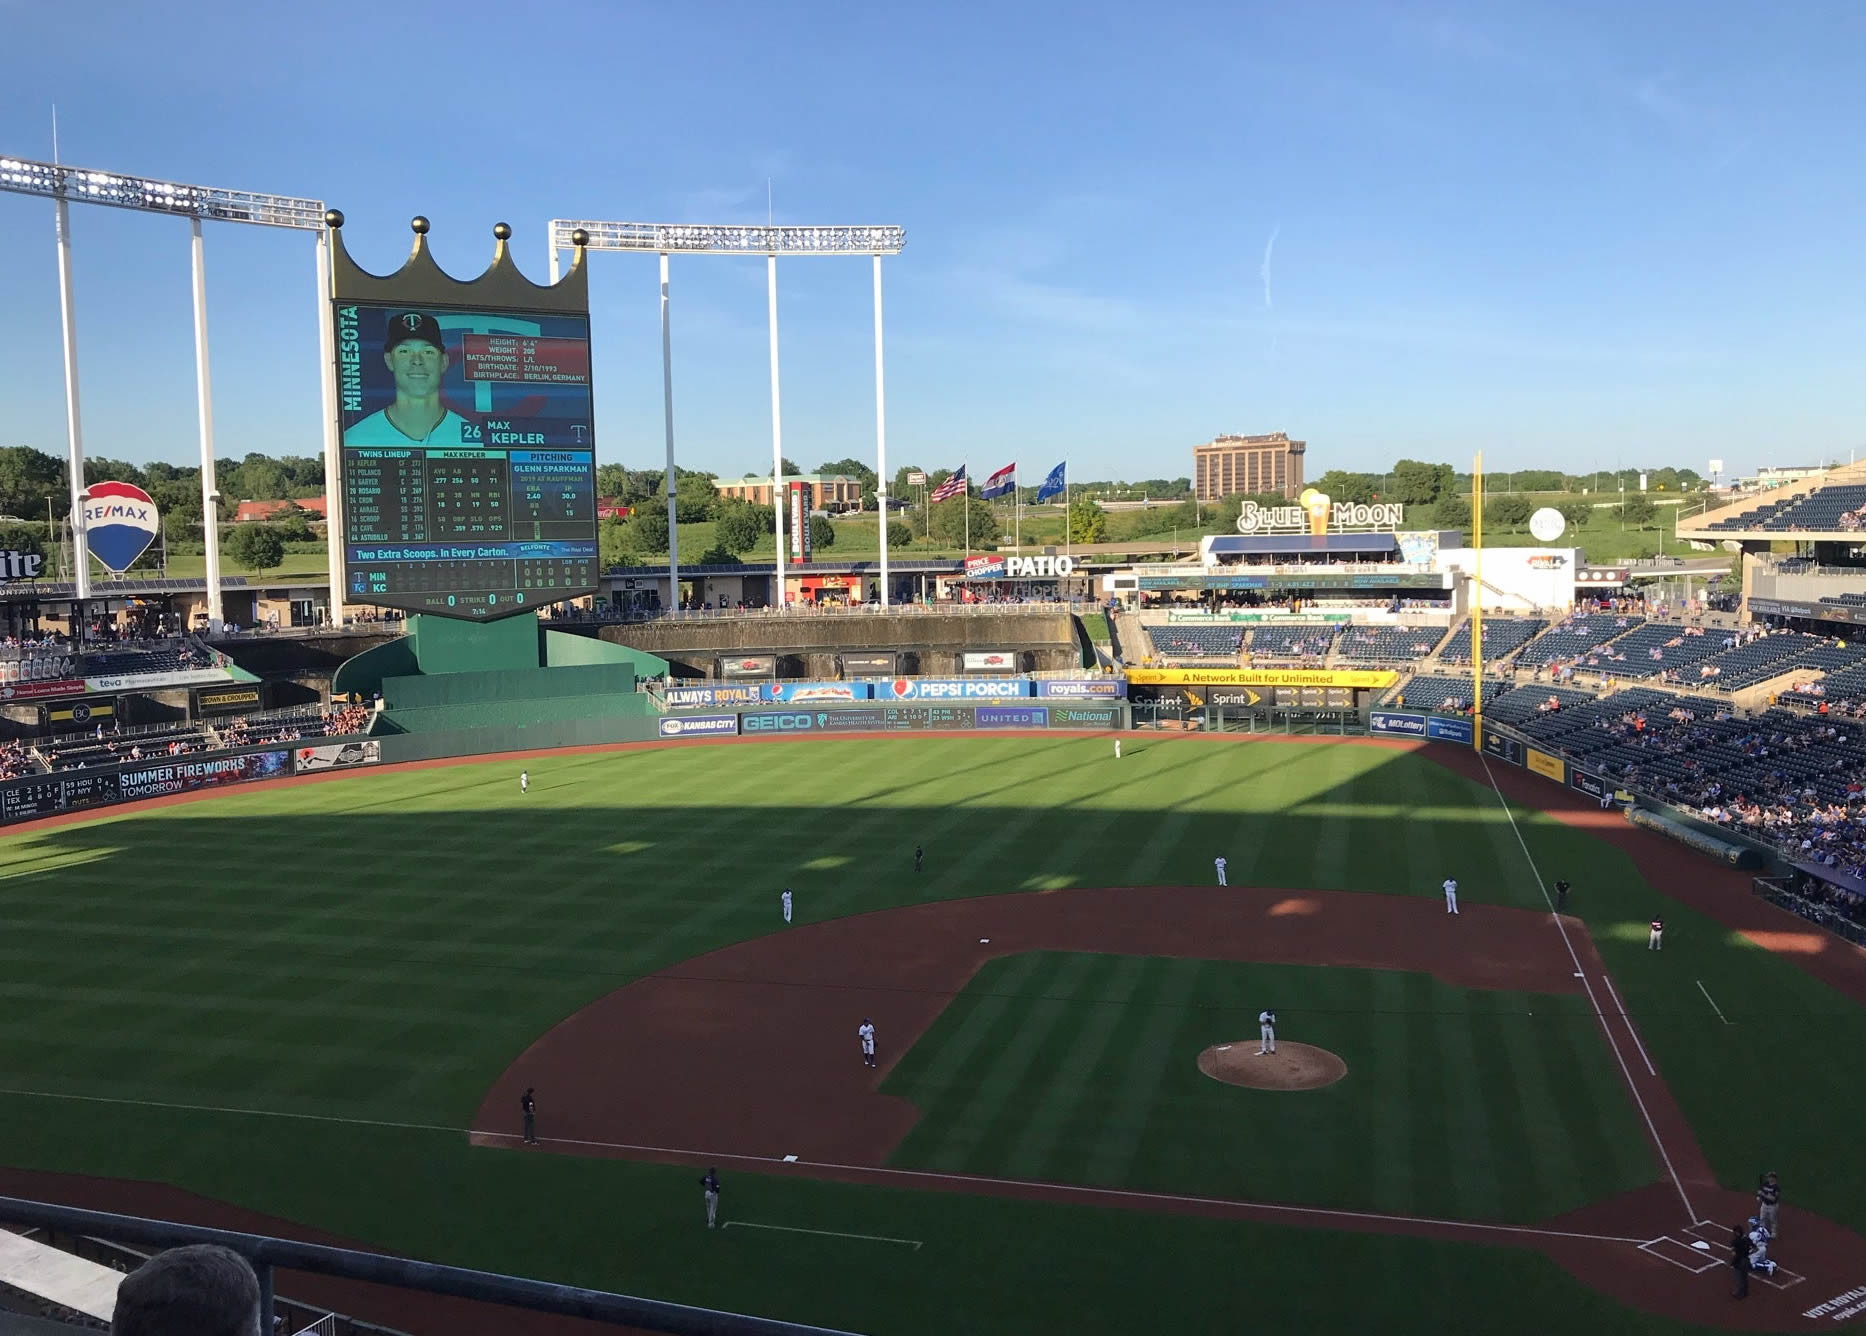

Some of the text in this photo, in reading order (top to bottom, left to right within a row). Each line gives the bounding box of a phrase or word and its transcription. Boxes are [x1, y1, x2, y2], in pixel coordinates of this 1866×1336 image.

[490, 338, 519, 346] HEIGHT:
[489, 346, 519, 354] WEIGHT:
[340, 305, 361, 411] MINNESOTA
[467, 354, 519, 362] BATS/THROWS:
[478, 363, 519, 371] BIRTHDATE:
[473, 371, 520, 379] BIRTHPLACE:
[552, 374, 585, 382] GERMANY
[487, 421, 511, 430] MAX
[463, 424, 482, 439] 26
[491, 432, 545, 445] KEPLER
[358, 450, 411, 458] TWINS LINEUP
[530, 453, 573, 461] PITCHING
[514, 465, 588, 473] GLENN SPARKMAN
[85, 505, 148, 521] RE/MAX
[1332, 502, 1403, 525] MOON
[520, 543, 551, 551] BELFONTE
[356, 547, 509, 560] Two Extra Scoops. In Every Carton.
[0, 550, 41, 578] ite
[967, 556, 989, 569] PRICE
[1007, 556, 1073, 577] PATIO
[966, 564, 1003, 578] CHOPPER
[369, 572, 386, 581] MIN
[0, 588, 34, 596] UNTAIN
[373, 584, 387, 592] KC
[447, 595, 456, 607] 0
[488, 593, 496, 605] 0
[516, 592, 524, 604] 0
[100, 679, 121, 688] teva
[1183, 674, 1334, 684] A Network Built for Unlimited
[921, 682, 1020, 697] PEPSI PORCH
[1050, 684, 1115, 696] royals.com
[667, 689, 750, 703] ALWAYS ROYAL
[1213, 693, 1246, 706] Sprint
[75, 709, 88, 718] BC
[981, 714, 1030, 722] UNITED
[1068, 711, 1113, 721] National
[684, 720, 716, 730] KANSAS
[717, 720, 735, 729] CITY
[743, 714, 812, 730] GEICO
[1388, 719, 1424, 731] MOLottery
[121, 768, 173, 787] SUMMER
[176, 757, 245, 778] FIREWORKS
[77, 778, 93, 787] HOU
[6, 789, 20, 797] CLE
[77, 787, 91, 795] NYY
[121, 780, 183, 798] TOMORROW
[7, 797, 21, 805] TEX
[1801, 1303, 1836, 1319] VOTE
